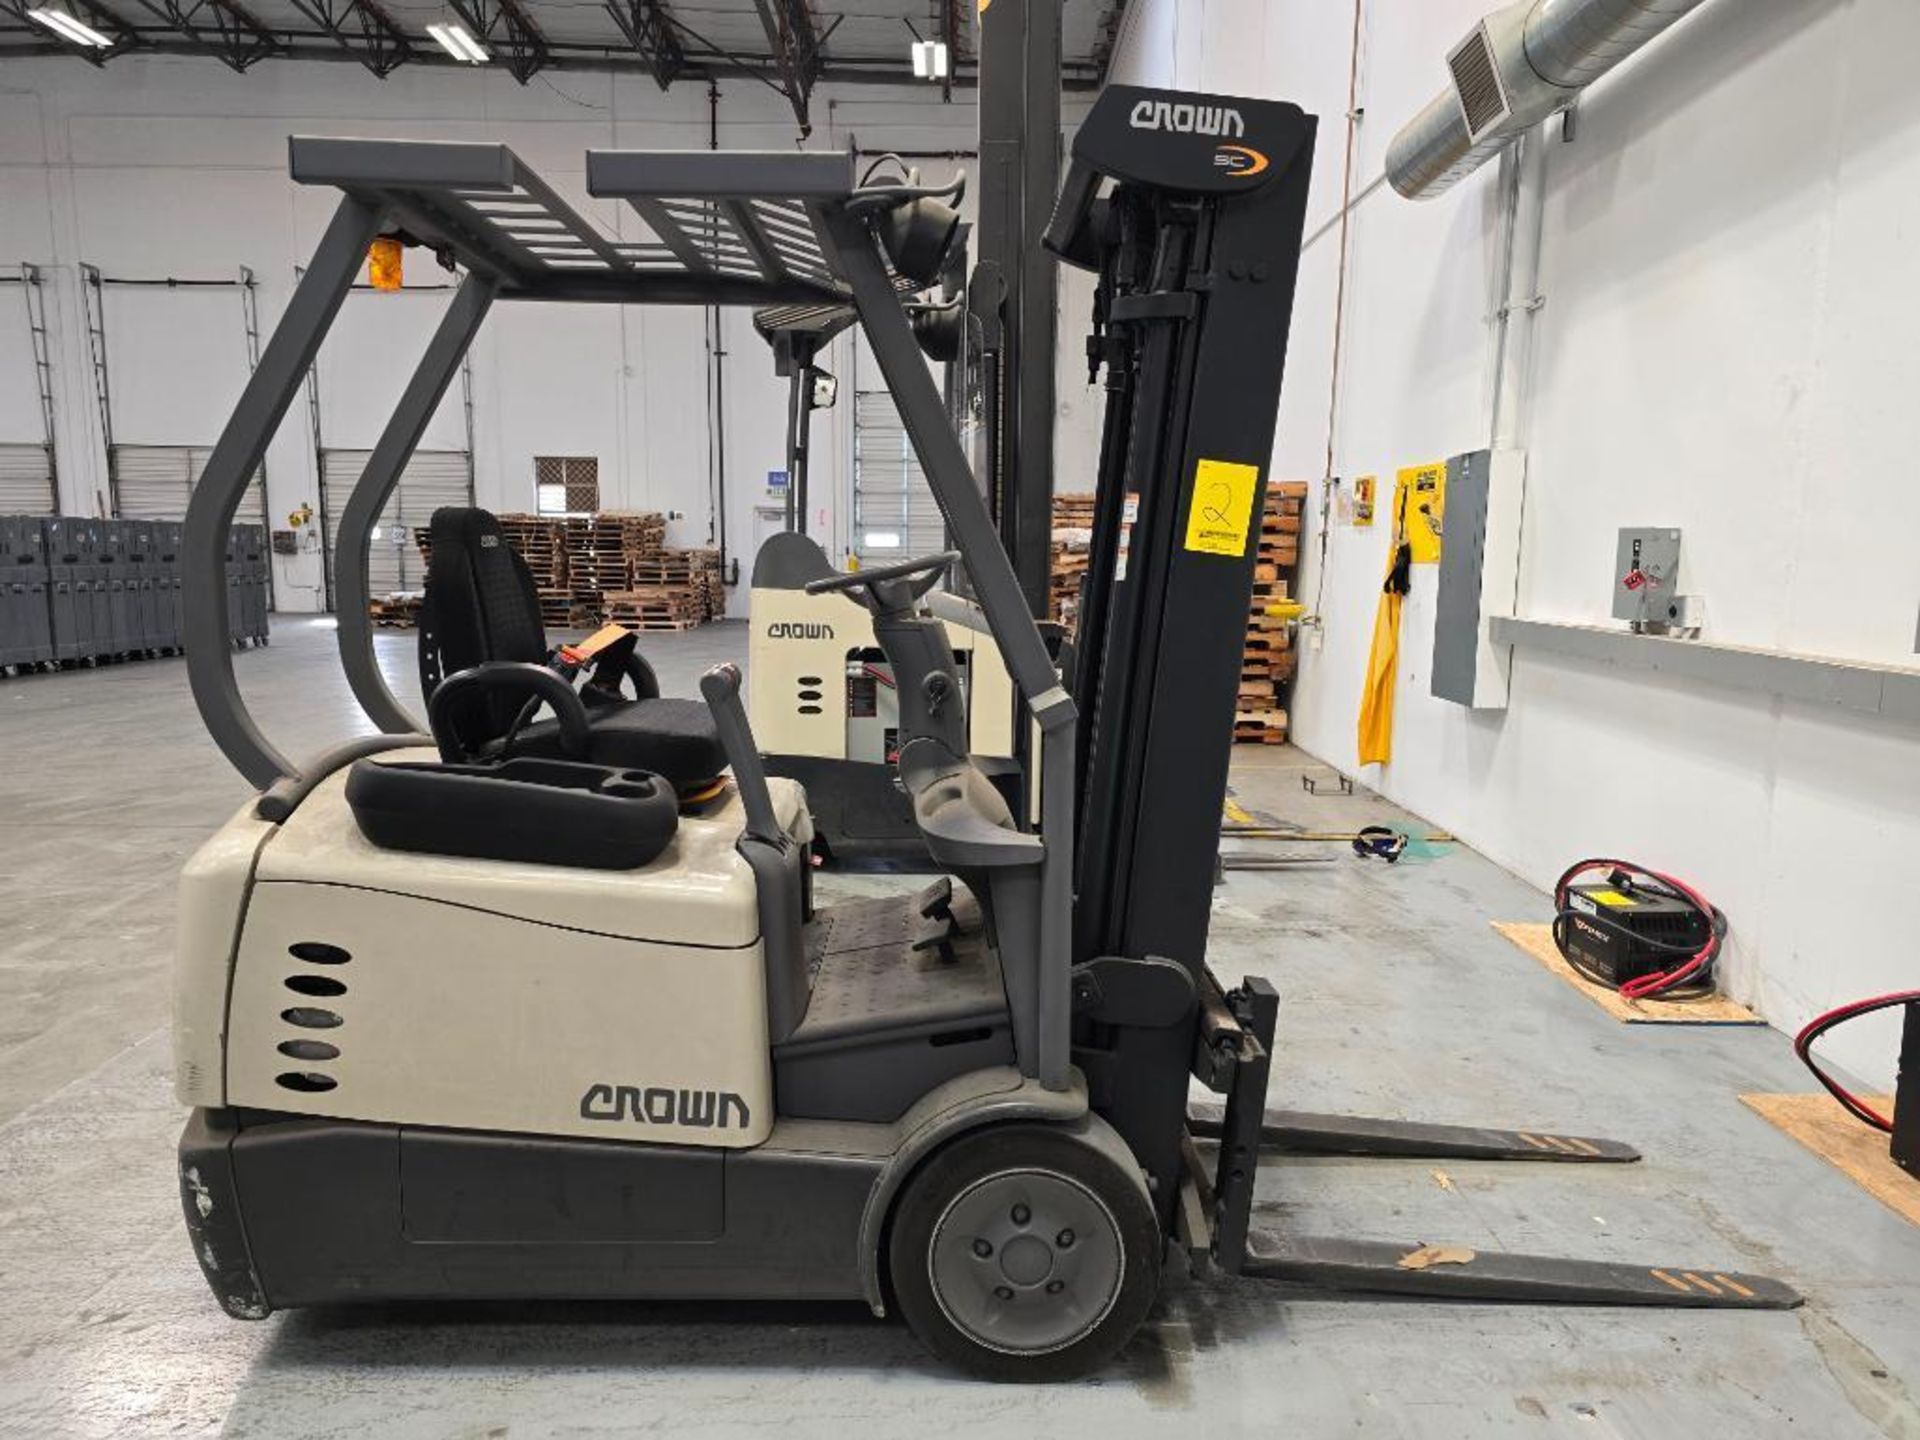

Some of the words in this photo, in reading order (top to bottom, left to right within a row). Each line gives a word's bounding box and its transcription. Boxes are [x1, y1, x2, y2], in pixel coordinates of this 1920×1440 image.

[1130, 100, 1245, 138] CROWN
[1213, 154, 1246, 168] SC
[1202, 482, 1232, 528] 2
[767, 622, 834, 640] CROWN
[580, 1083, 750, 1129] CROWN
